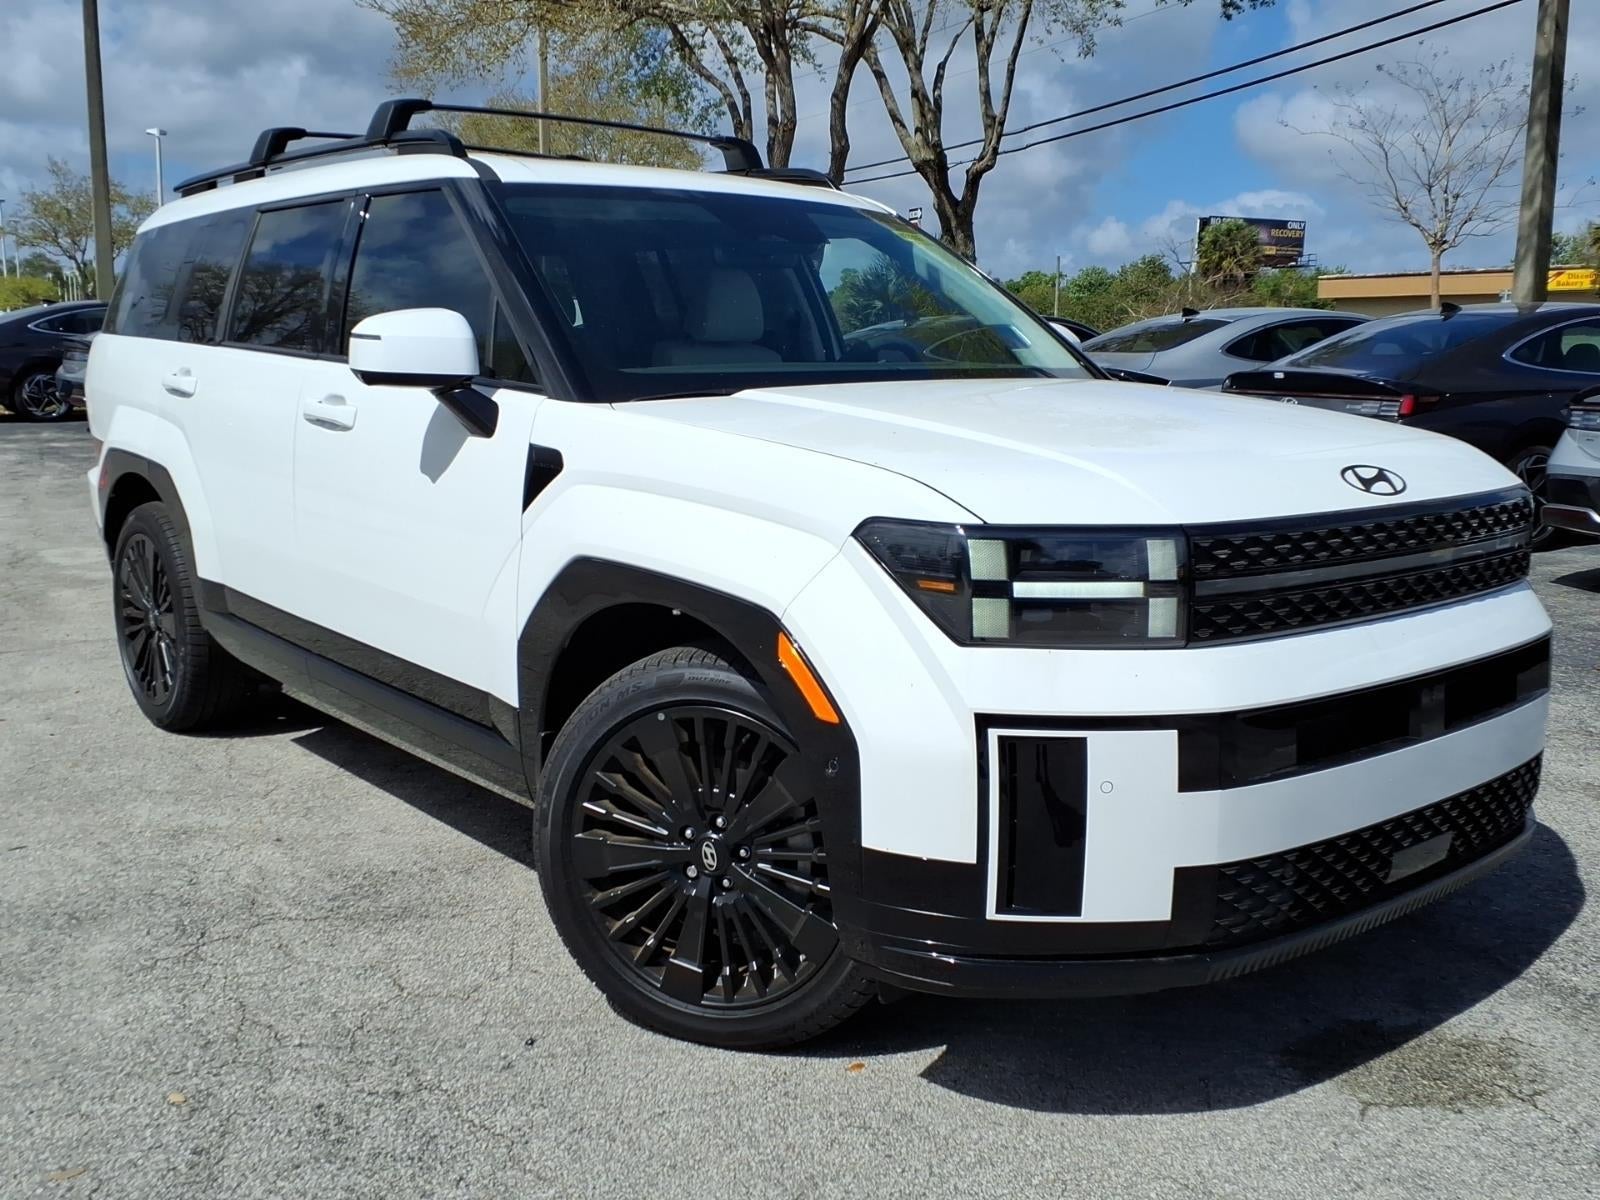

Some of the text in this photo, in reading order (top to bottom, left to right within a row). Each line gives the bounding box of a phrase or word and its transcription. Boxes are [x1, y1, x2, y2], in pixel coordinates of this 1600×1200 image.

[1287, 221, 1305, 229] ONLY
[1271, 229, 1304, 238] RECOVERY
[1556, 280, 1584, 288] Bakery
